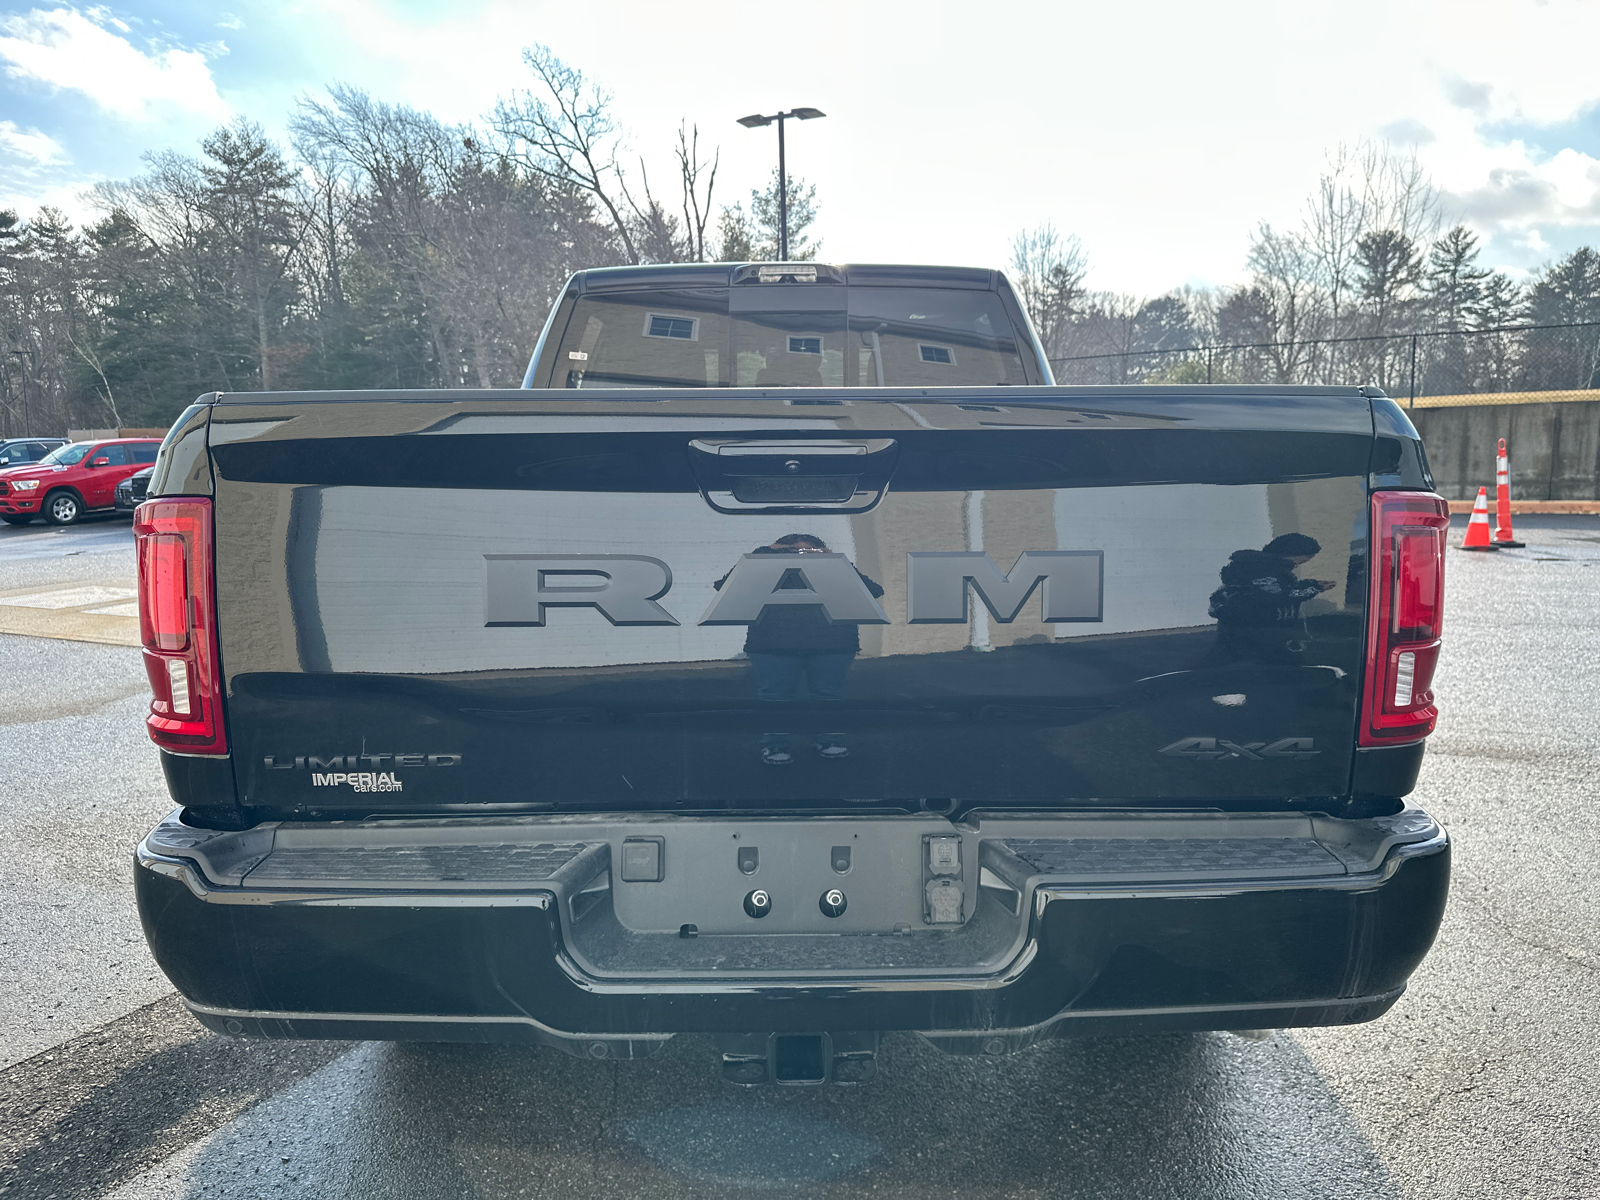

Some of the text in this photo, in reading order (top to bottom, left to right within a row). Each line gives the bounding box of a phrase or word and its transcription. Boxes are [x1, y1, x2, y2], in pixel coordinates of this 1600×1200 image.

[482, 549, 1105, 628] RAM
[263, 752, 464, 770] LIMITED
[311, 772, 403, 787] IMPERIAL
[353, 783, 403, 793] cars.com
